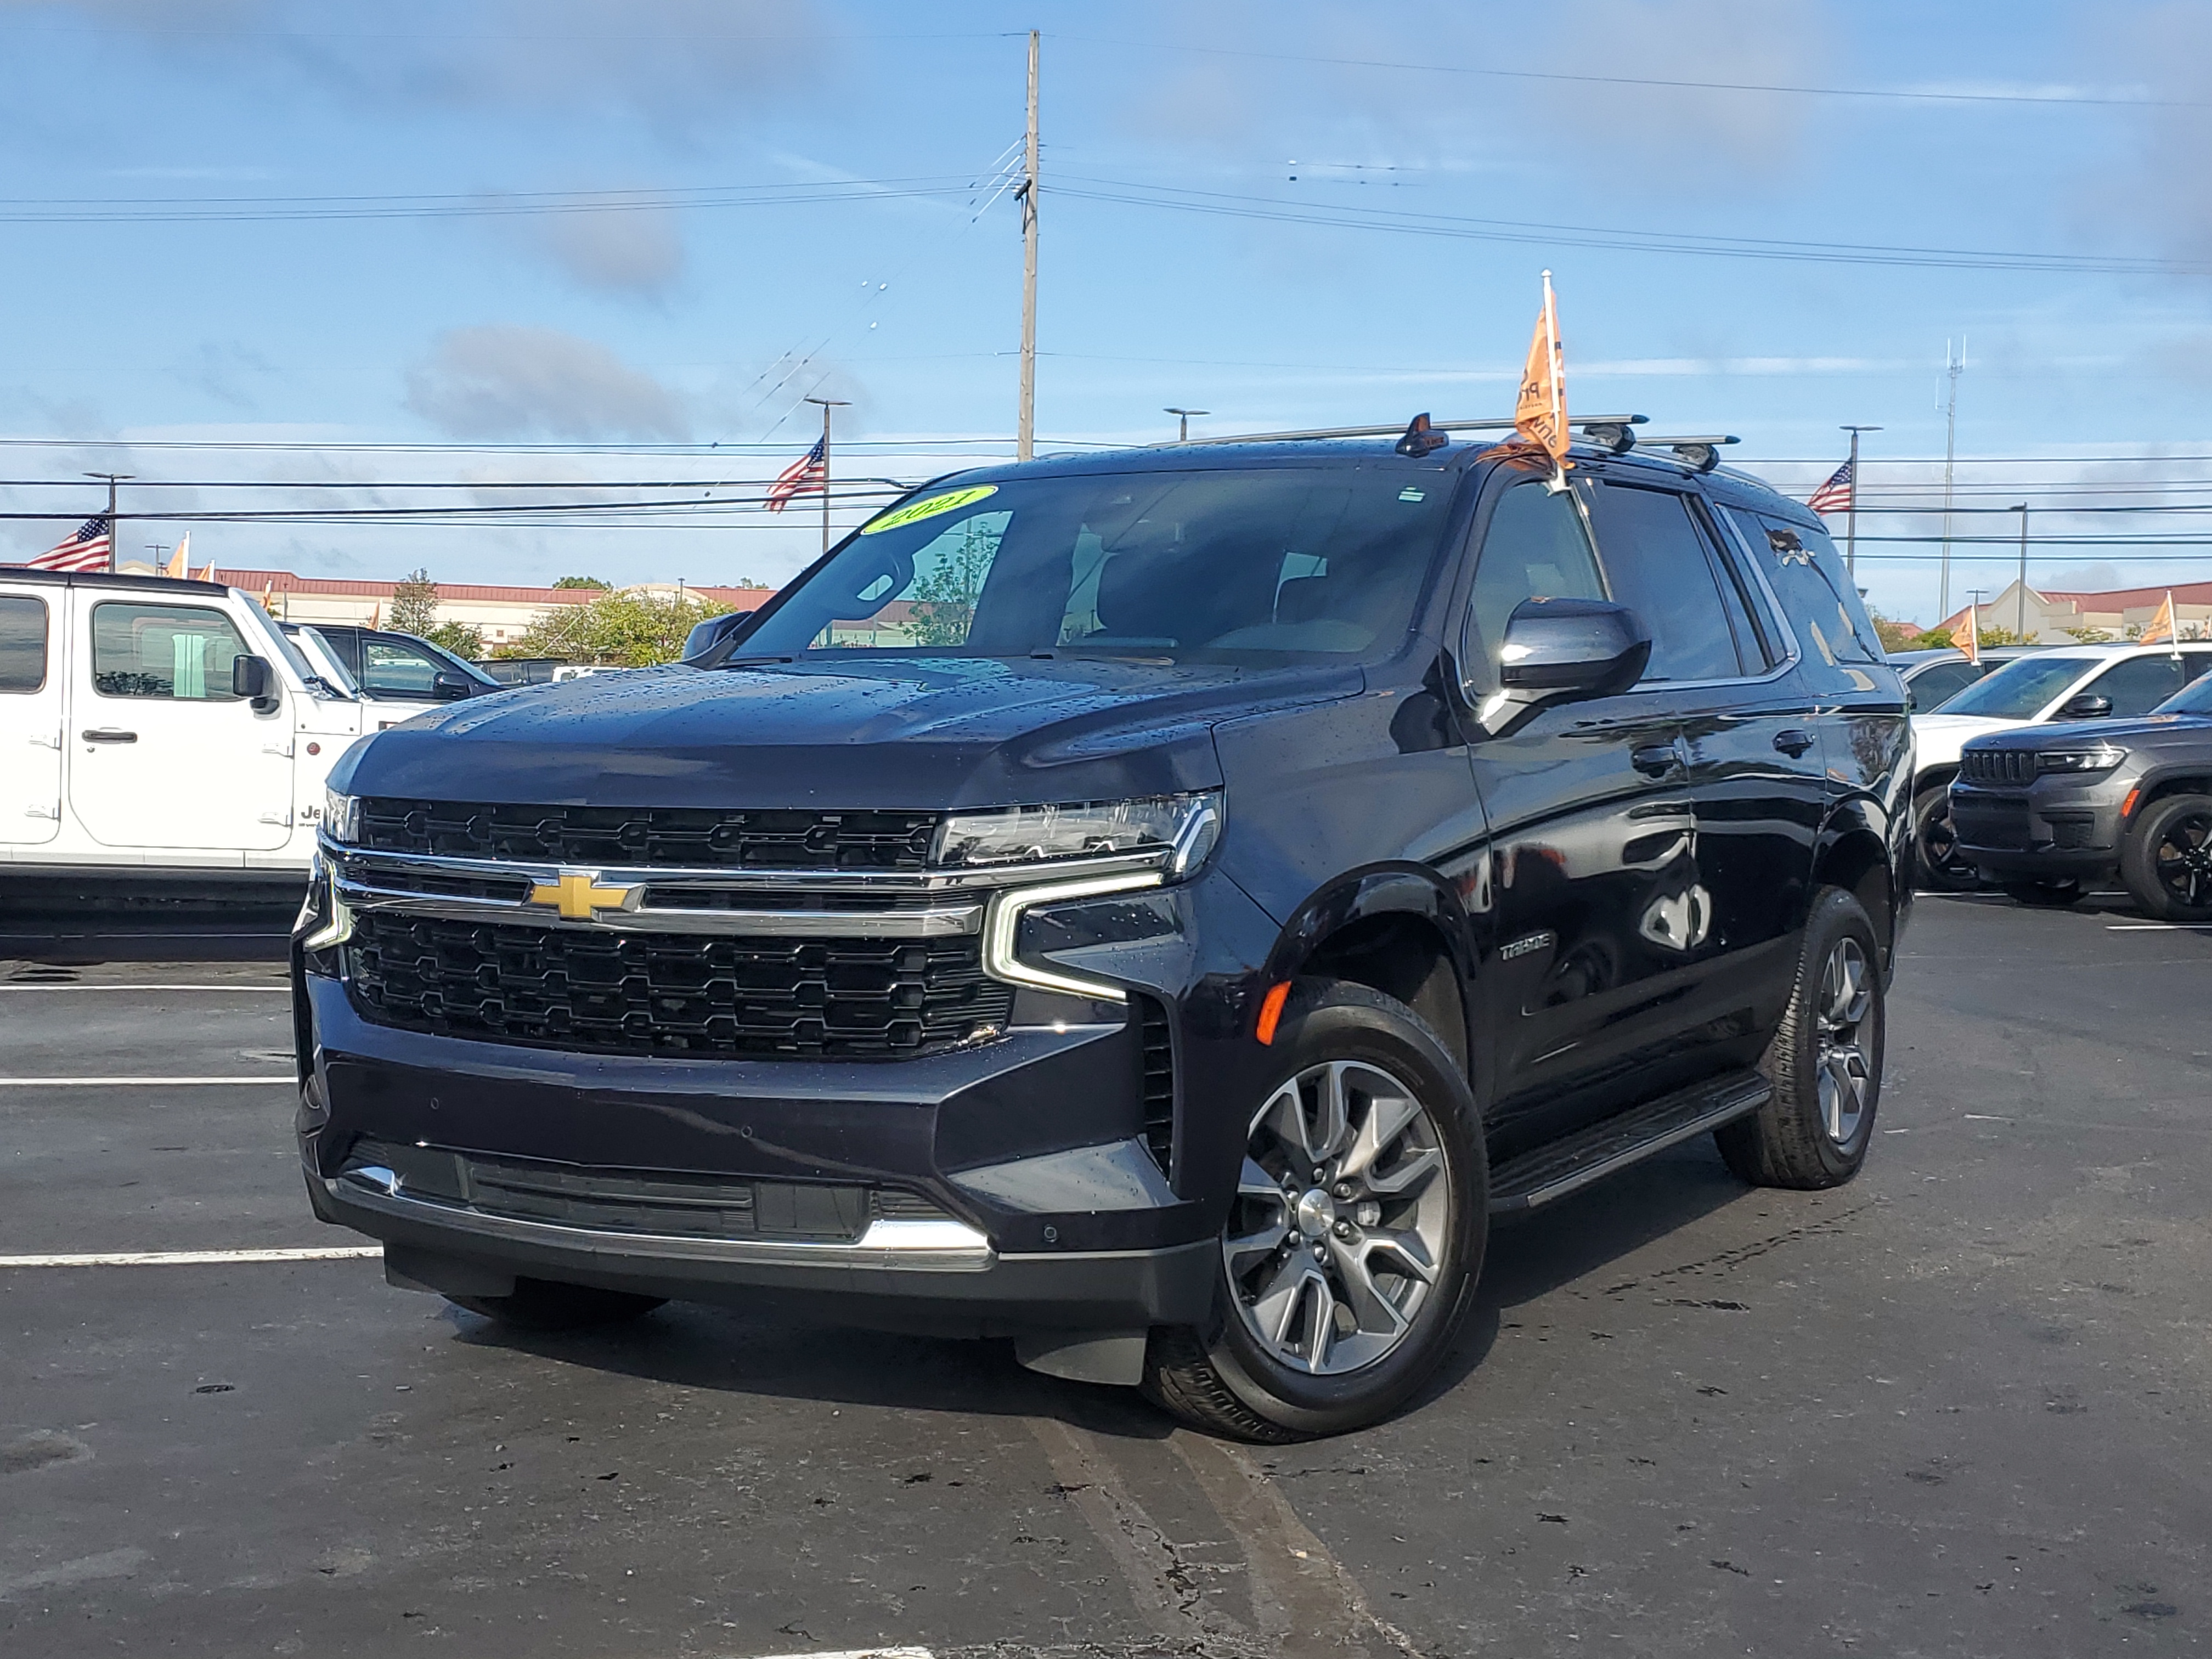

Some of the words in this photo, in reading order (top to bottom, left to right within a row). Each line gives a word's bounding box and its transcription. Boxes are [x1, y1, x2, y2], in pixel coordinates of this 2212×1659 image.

[880, 490, 976, 529] 2021
[301, 805, 320, 819] Je
[1499, 933, 1550, 961] TAHOE
